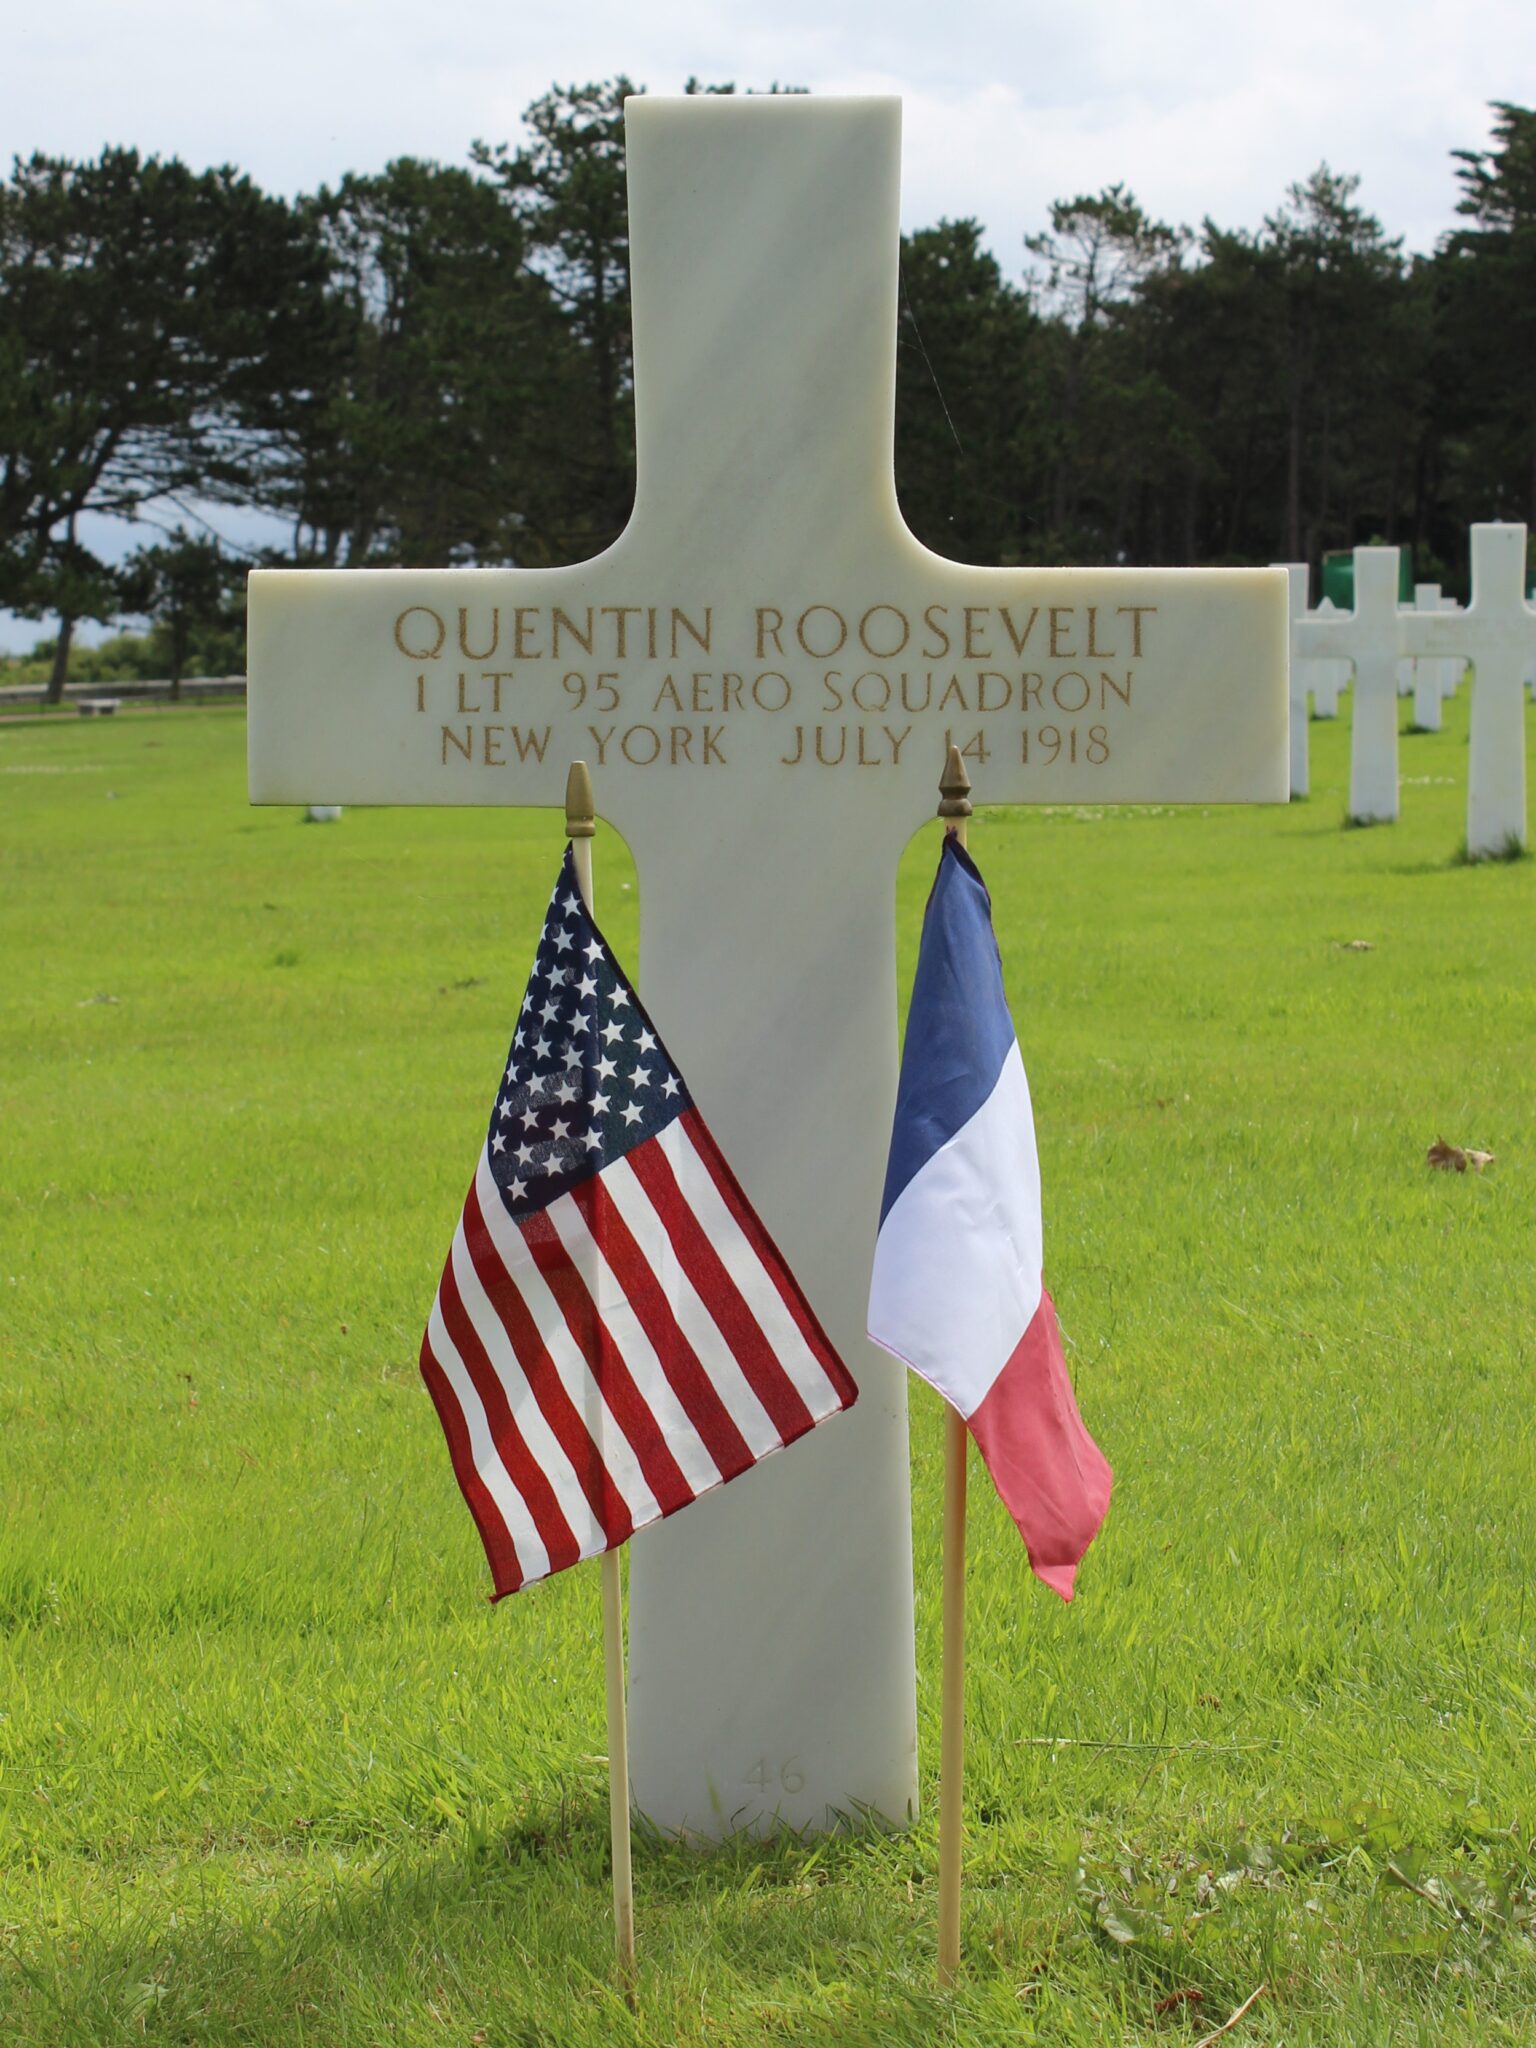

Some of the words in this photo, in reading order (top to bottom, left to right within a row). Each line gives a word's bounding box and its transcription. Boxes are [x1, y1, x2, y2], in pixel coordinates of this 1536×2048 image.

[393, 605, 713, 661] QUENTIN
[754, 604, 1159, 660] ROOSEVELT
[416, 672, 426, 713] 1
[457, 672, 514, 713] LT
[562, 671, 621, 713] 95
[652, 671, 792, 713] AERO
[822, 671, 1134, 713] SQUADRON
[440, 725, 553, 766] NEW
[588, 725, 727, 766] YORK
[781, 725, 912, 766] JULY
[944, 727, 991, 765] 14
[1021, 725, 1111, 767] 1918
[742, 1755, 806, 1795] 46
